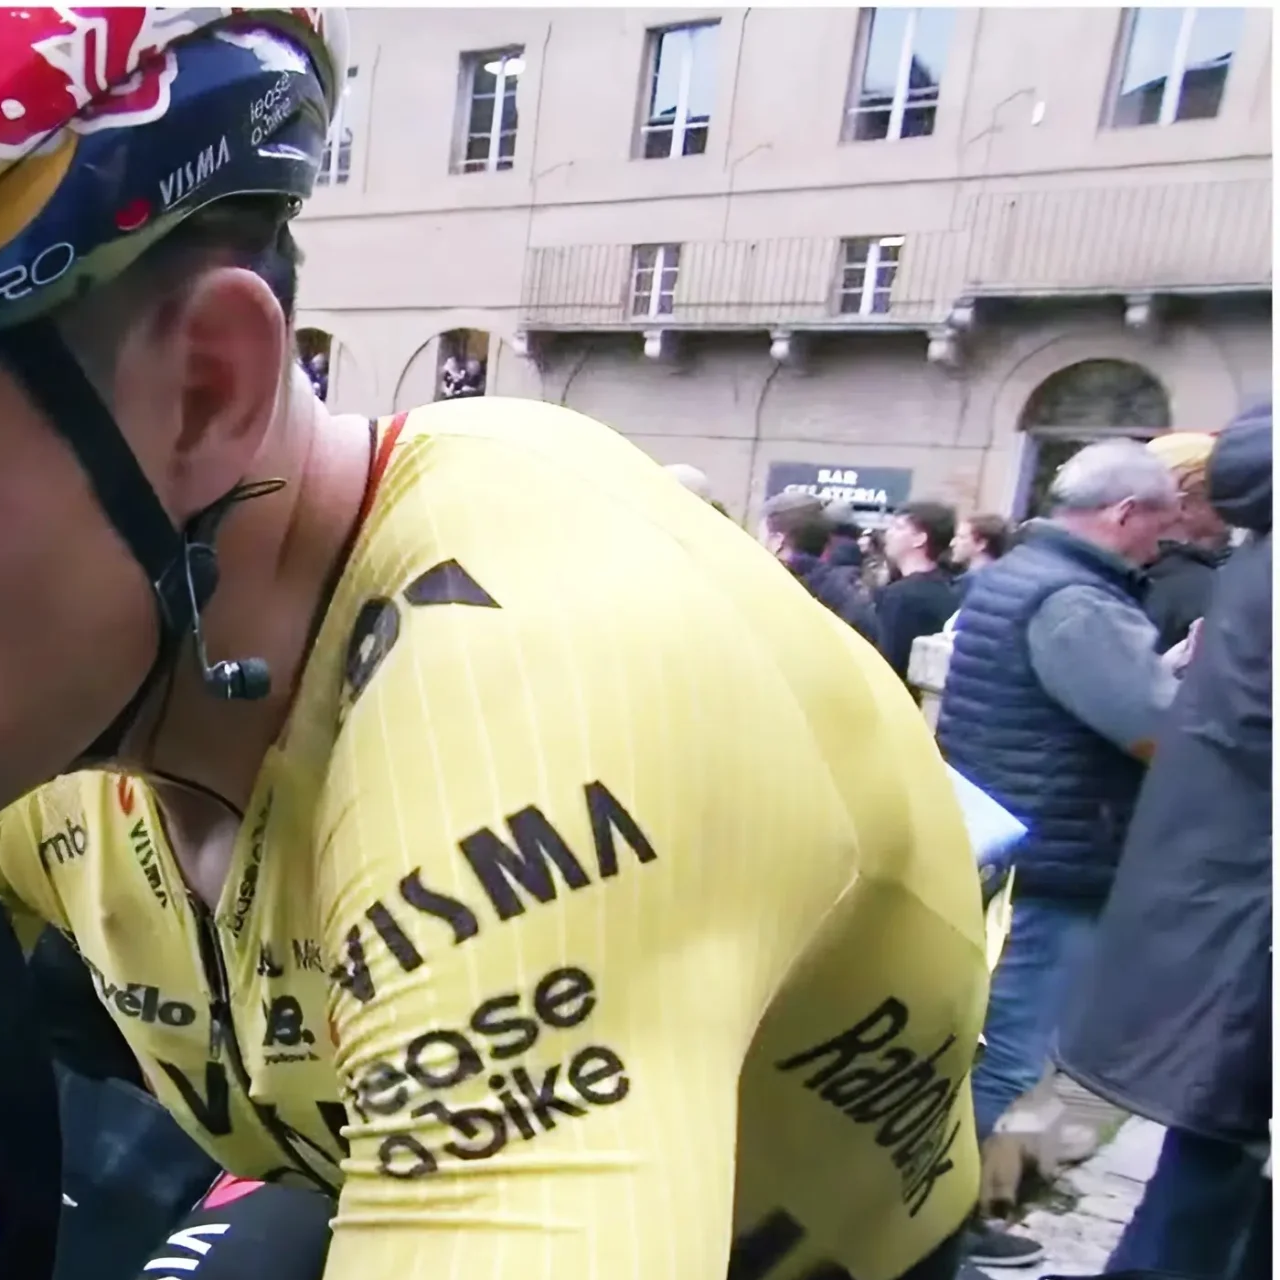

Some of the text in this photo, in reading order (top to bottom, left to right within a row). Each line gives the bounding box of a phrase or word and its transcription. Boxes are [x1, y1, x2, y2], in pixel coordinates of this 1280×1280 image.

[160, 136, 230, 205] VISMA
[818, 469, 858, 485] BAR
[331, 780, 657, 1004] VISMA
